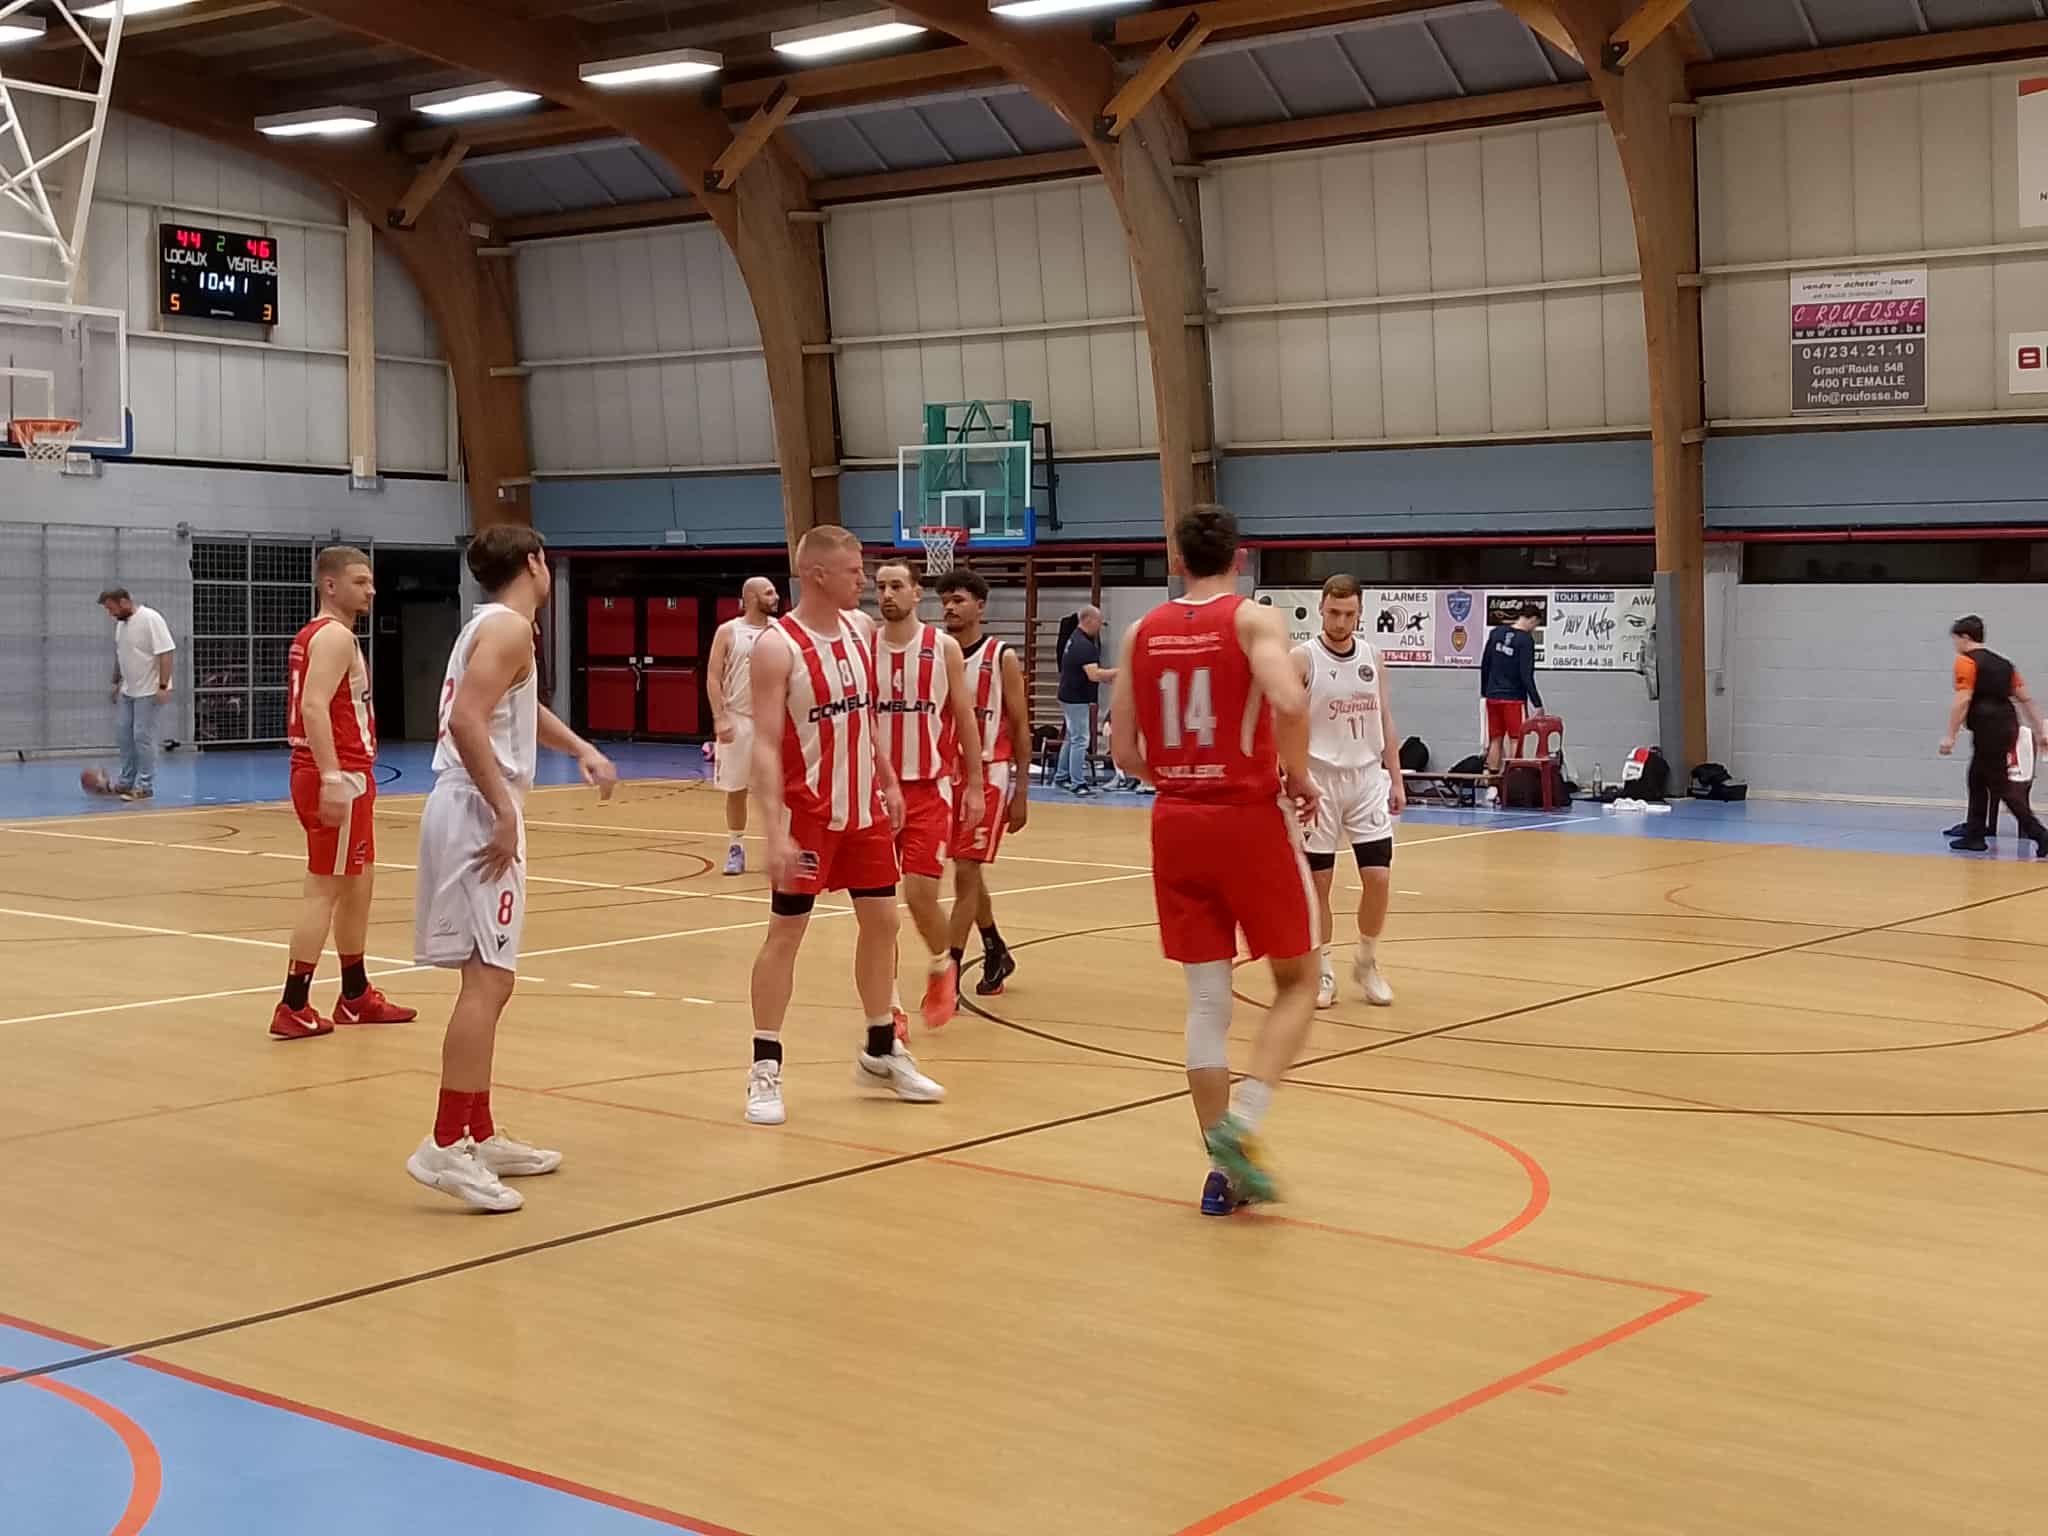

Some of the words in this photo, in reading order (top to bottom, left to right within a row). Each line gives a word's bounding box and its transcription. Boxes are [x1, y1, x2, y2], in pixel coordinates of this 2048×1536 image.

[177, 230, 201, 249] 44
[217, 235, 226, 252] 2
[164, 248, 208, 267] LOCAUX
[246, 240, 270, 258] 46
[227, 256, 278, 276] VISITEURS
[170, 292, 181, 311] 5
[1816, 300, 1924, 321] ROUFOSSE
[262, 303, 273, 321] 3
[1795, 324, 1922, 338] www.roufosse.be
[1802, 343, 1914, 360] 04/234.21.10
[1811, 378, 1840, 388] 4400
[1380, 592, 1428, 602] ALARMES
[1555, 592, 1580, 601] TOUS
[1400, 634, 1425, 646] ADLS
[1159, 668, 1217, 748] 14
[498, 890, 513, 925] 8
